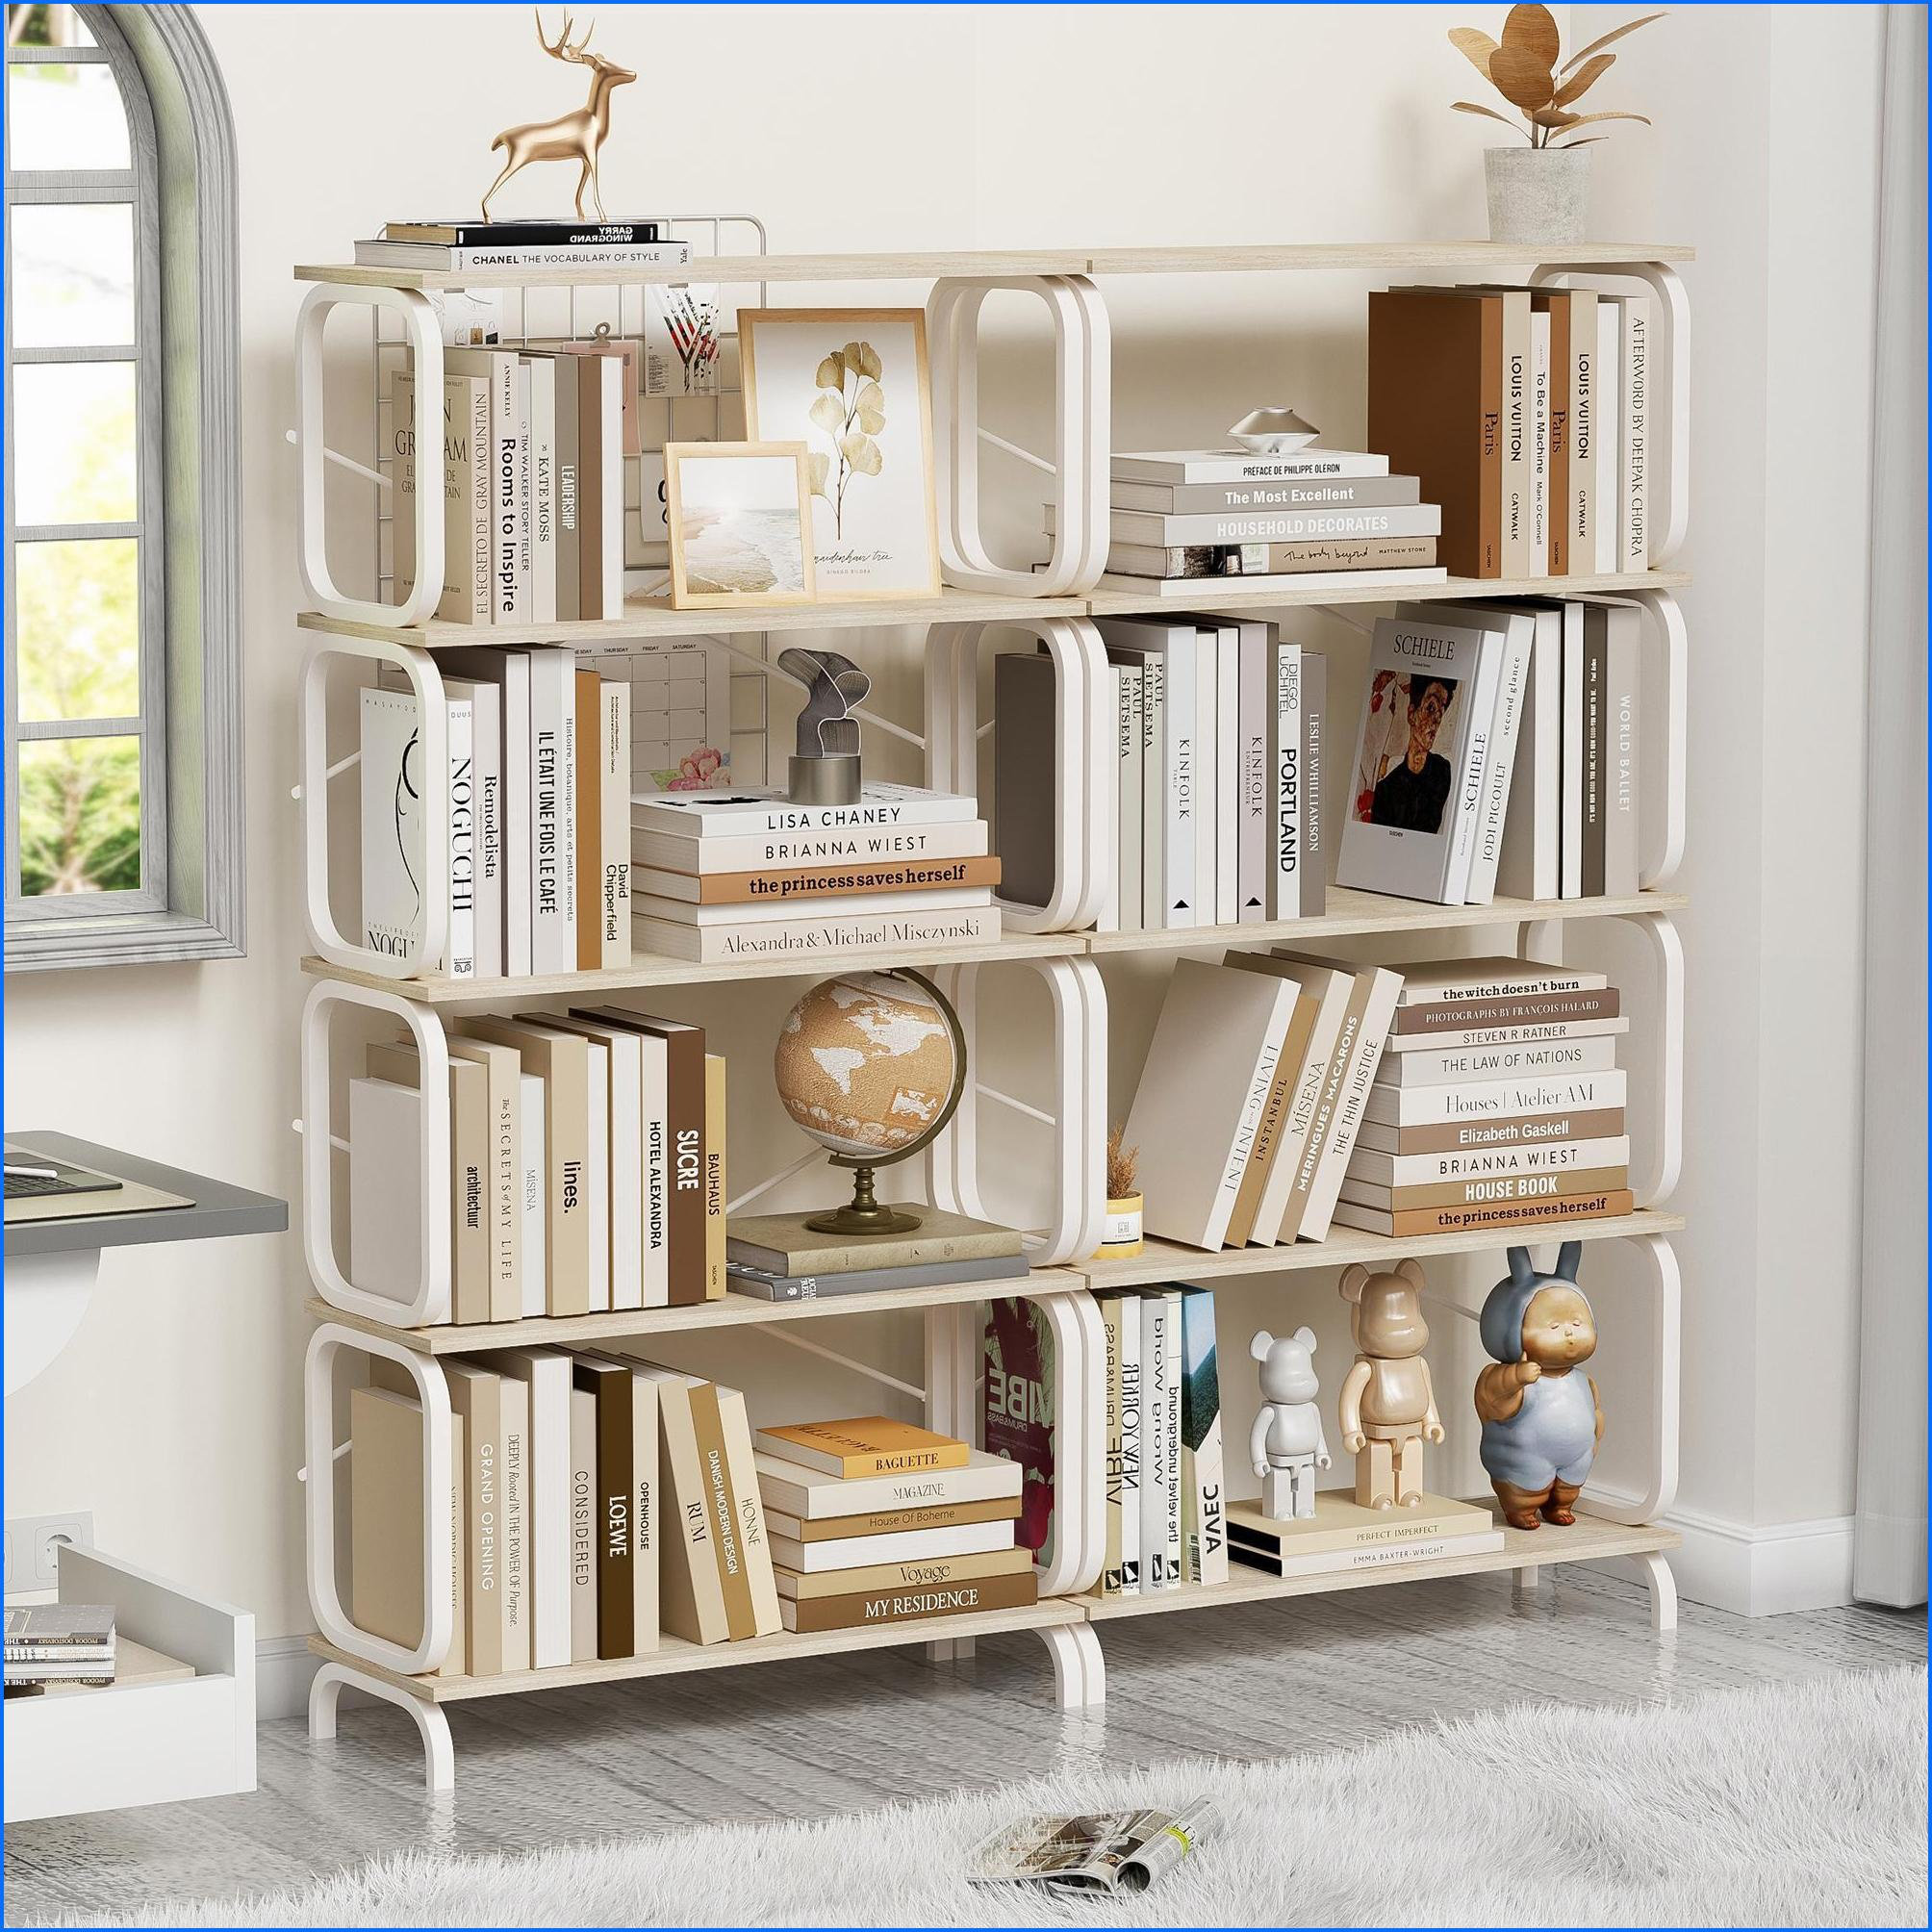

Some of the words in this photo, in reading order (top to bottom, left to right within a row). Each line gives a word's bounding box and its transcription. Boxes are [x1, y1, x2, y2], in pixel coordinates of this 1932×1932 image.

[472, 255, 520, 265] CHANEL
[522, 255, 541, 264] THE
[545, 253, 611, 263] VOCABULARY
[614, 253, 627, 262] OF
[630, 252, 660, 261] STYLE
[679, 247, 688, 264] Yale
[1511, 355, 1522, 397] LOUIS
[1537, 371, 1546, 387] To
[1632, 318, 1645, 410] AFTERWORD
[1537, 390, 1546, 407] Be
[475, 393, 488, 470] MOUNTAIN
[521, 434, 529, 451] TIM
[1485, 412, 1499, 456] Paris
[1511, 402, 1522, 462] VUITTON
[1632, 415, 1644, 433] BY
[1537, 422, 1546, 474] Machine
[1631, 438, 1643, 493] DEEPAK
[501, 439, 516, 501] Rooms
[521, 454, 529, 497] WALKER
[539, 456, 549, 496] KATE
[476, 474, 488, 510] GRAY
[561, 465, 575, 530] LEADERSHIP
[1225, 492, 1251, 505] The
[1253, 490, 1287, 503] Most
[1291, 487, 1355, 502] Excellent
[476, 517, 488, 534] DE
[502, 513, 517, 535] to
[521, 501, 529, 533] STORY
[539, 501, 550, 542] MOSS
[1217, 517, 1304, 537] HOUSEHOLD
[1307, 515, 1388, 533] DECORATES
[1511, 493, 1519, 541] CATWALK
[1631, 497, 1643, 556] CHOPRA
[476, 538, 489, 597] SECRETO
[521, 538, 530, 572] TELLER
[498, 542, 518, 612] Inspire
[476, 600, 489, 614] EL
[1393, 634, 1456, 661] SCHIELE
[1279, 656, 1288, 720] UCHITEL
[1288, 663, 1298, 710] DIEGO
[1508, 656, 1521, 695] glance
[1121, 676, 1131, 759] SIETSEMA
[1132, 677, 1143, 719] PAUL
[1503, 698, 1514, 736] second
[539, 731, 554, 745] IL
[1618, 695, 1631, 753] WORLD
[539, 748, 558, 787] ÉTAIT
[1179, 739, 1190, 820] KINFOLK
[1464, 733, 1487, 812] SCHIELE
[1618, 758, 1630, 813] BALLET
[539, 791, 555, 819] UNE
[1281, 749, 1297, 873] PORTLAND
[1488, 762, 1507, 825] PICOULT
[451, 757, 472, 912] NOGUCHI
[484, 775, 500, 878] Remodelista
[768, 813, 810, 830] LISA
[821, 807, 902, 827] CHANEY
[540, 824, 555, 854] FOIS
[765, 841, 857, 860] BRIANNA
[868, 835, 928, 853] WIEST
[1483, 828, 1497, 861] JODI
[540, 858, 555, 875] LE
[618, 864, 628, 899] David
[750, 877, 778, 895] the
[780, 874, 854, 897] princess
[856, 870, 903, 887] saves
[904, 865, 966, 884] herself
[540, 878, 559, 914] CAFÉ
[604, 864, 618, 941] Chipperfield
[721, 930, 804, 954] Alexandra
[806, 931, 820, 948] &
[823, 923, 887, 947] Michael
[892, 919, 979, 945] Misczynski
[1443, 989, 1464, 1000] the
[1465, 985, 1501, 998] witch
[1502, 980, 1548, 995] doesn't
[1550, 979, 1581, 992] burn
[1425, 1008, 1498, 1025] PHOTOGRAPHS
[1499, 1007, 1512, 1018] BY
[1513, 1004, 1560, 1017] FRANÇOIS
[1561, 1000, 1599, 1013] HALARD
[1354, 1039, 1379, 1095] JUSTICE
[1441, 1058, 1467, 1073] THE
[1473, 1055, 1500, 1069] LAW
[1504, 1053, 1521, 1067] OF
[1526, 1048, 1583, 1065] NATIONS
[1255, 1079, 1288, 1161] INSTANBUL
[1298, 1105, 1331, 1193] MERINGUES
[1326, 1015, 1359, 1102] MACARONS
[1341, 1096, 1361, 1127] THIN
[1445, 1094, 1499, 1114] Houses
[1512, 1087, 1562, 1110] Atelier
[649, 1121, 661, 1165] HOTEL
[1332, 1131, 1351, 1156] THE
[1459, 1124, 1519, 1144] Elizabeth
[1522, 1120, 1570, 1139] Gaskell
[676, 1130, 699, 1191] SUCRE
[467, 1165, 482, 1230] architectuur
[564, 1161, 581, 1213] lines.
[708, 1154, 721, 1216] BAUHAUS
[1464, 1180, 1514, 1202] HOUSE
[1517, 1176, 1559, 1196] BOOK
[649, 1168, 662, 1250] ALEXANDRA
[481, 1443, 494, 1504] GRAND
[707, 1449, 724, 1489] DANISH
[876, 1452, 939, 1471] BAGUETTE
[574, 1470, 589, 1587] CONSIDERED
[609, 1495, 627, 1558] LOEWE
[640, 1482, 649, 1551] OPENHOUSE
[715, 1489, 732, 1536] MODERN
[481, 1512, 495, 1591] OPENING
[1356, 1531, 1390, 1541] PERFECT
[1394, 1525, 1439, 1538] IMPERFECT
[723, 1536, 739, 1575] DESIGN
[900, 1563, 952, 1585] Voyage
[1353, 1555, 1377, 1564] EMMA
[1379, 1545, 1444, 1561] BAXTER-WRIGHT
[865, 1600, 891, 1618] MY
[892, 1589, 979, 1615] RESIDENCE
